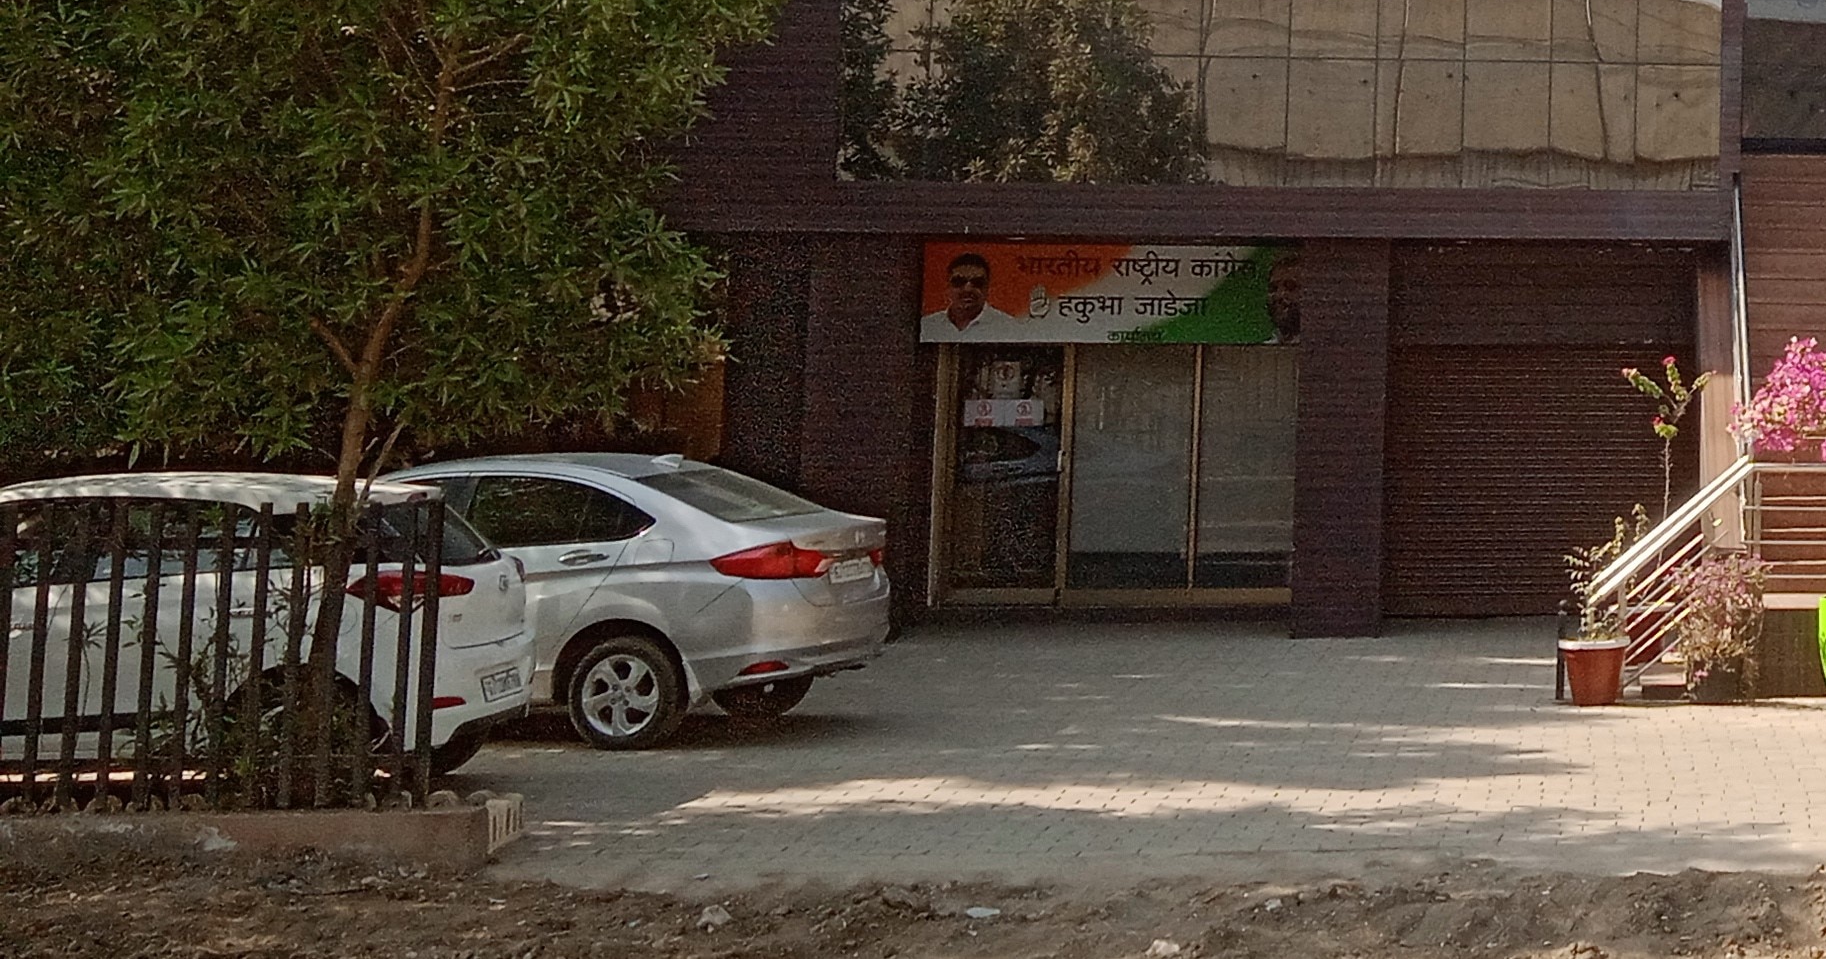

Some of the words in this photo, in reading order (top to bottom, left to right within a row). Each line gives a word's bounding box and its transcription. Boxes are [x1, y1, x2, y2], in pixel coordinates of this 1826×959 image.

[1017, 250, 1100, 277] भारतीय
[1112, 250, 1182, 285] राष्ट्रीय
[1058, 295, 1124, 324] हकुभा
[1134, 290, 1209, 317] जाडेजा
